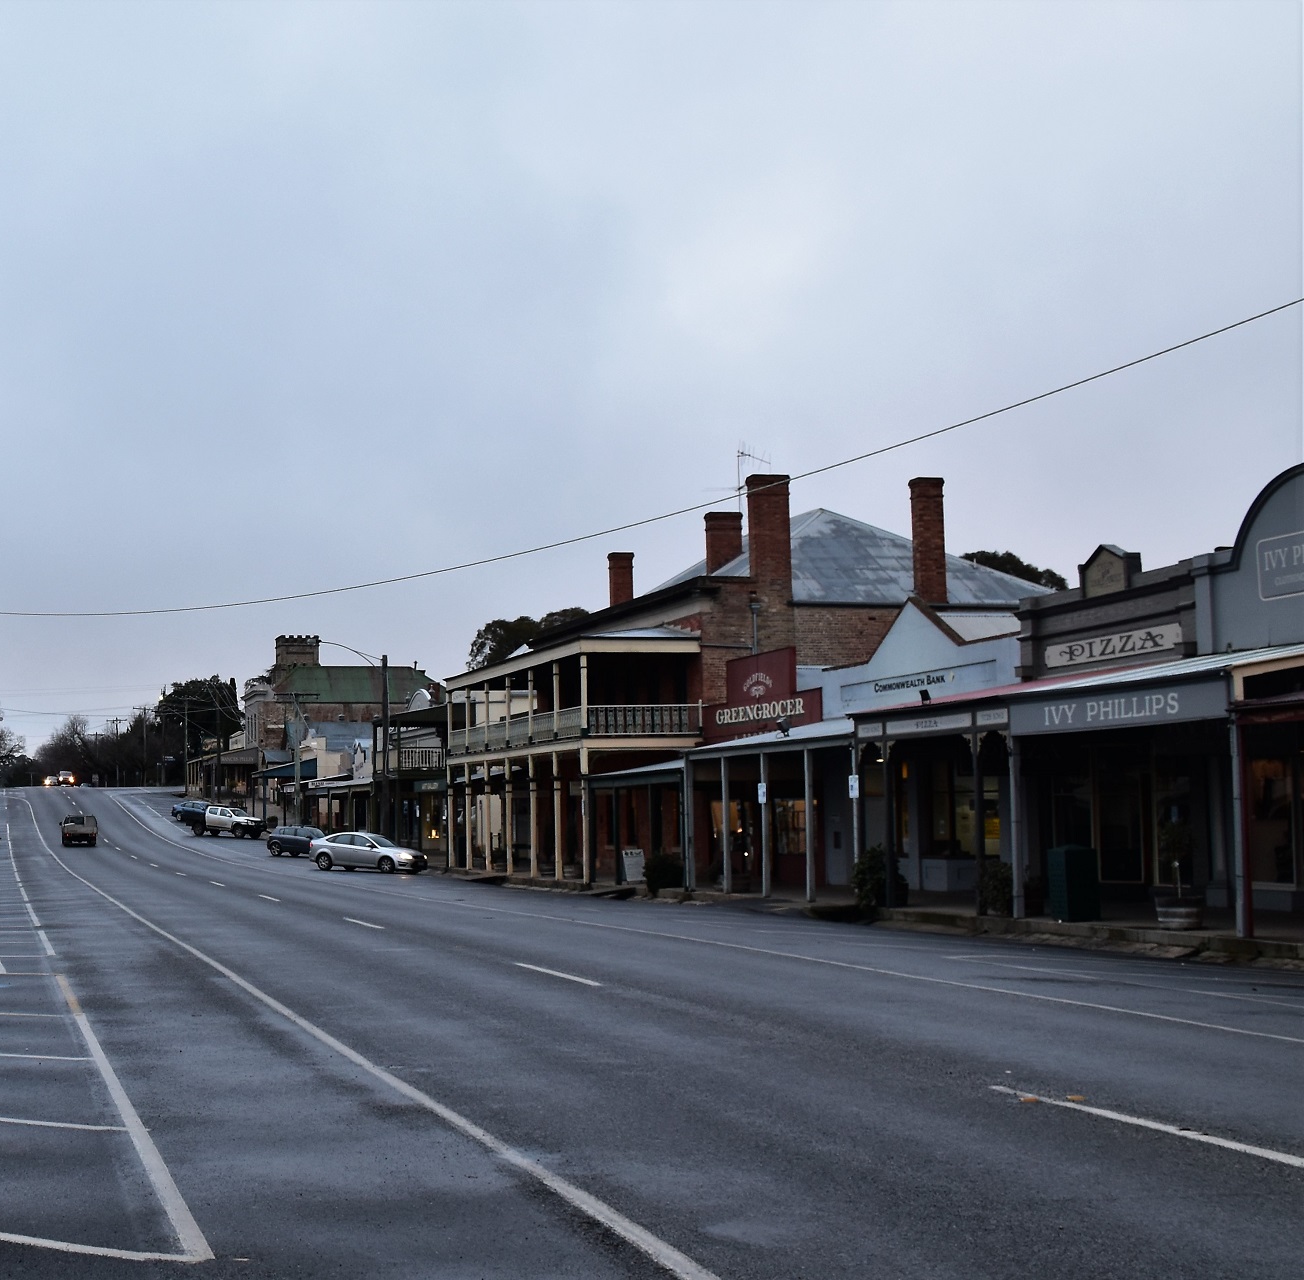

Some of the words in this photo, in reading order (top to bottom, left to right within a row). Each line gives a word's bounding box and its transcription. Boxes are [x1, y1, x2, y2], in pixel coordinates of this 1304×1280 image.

[1263, 547, 1289, 572] IVY
[1059, 631, 1165, 662] PIZZA
[743, 672, 773, 692] GOLDFIELDS
[874, 678, 925, 693] COMMONWEALTH
[926, 674, 946, 686] BANK
[715, 697, 805, 725] GREENGROCER
[1043, 703, 1077, 726] IVY
[1086, 692, 1180, 722] PHILLIPS
